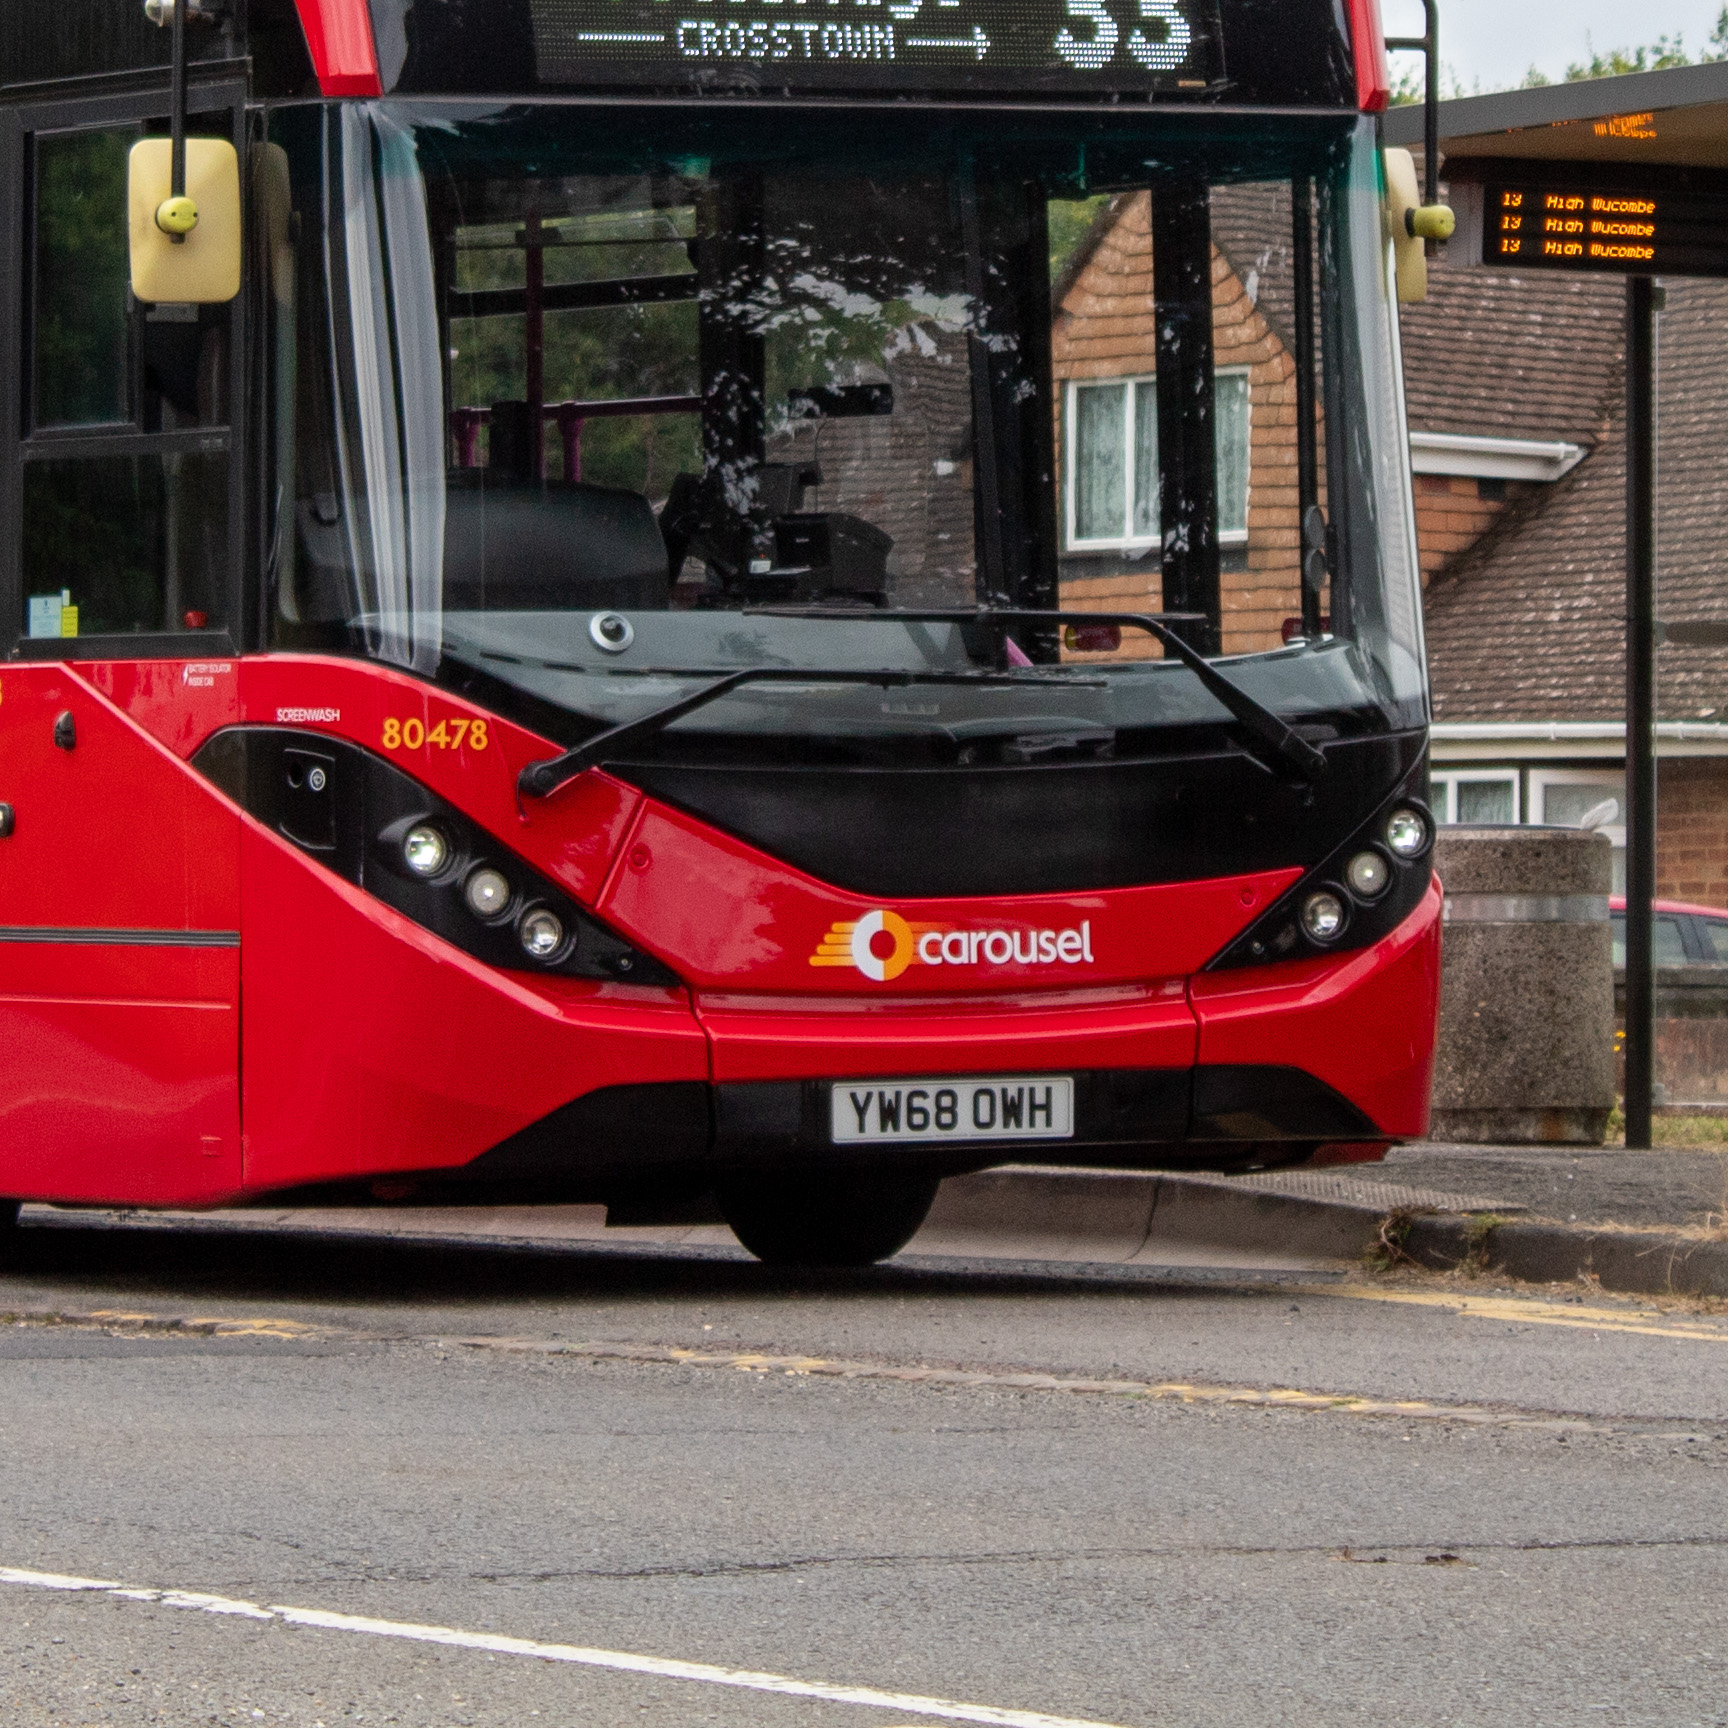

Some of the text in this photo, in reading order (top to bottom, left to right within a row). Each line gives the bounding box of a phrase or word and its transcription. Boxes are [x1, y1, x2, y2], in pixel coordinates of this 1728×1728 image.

[676, 21, 895, 60] CROSSTOWN
[276, 707, 341, 722] SCREENWASH
[382, 717, 488, 751] 80478
[918, 920, 1094, 965] carousel
[850, 1086, 1053, 1133] YW68 OWH
